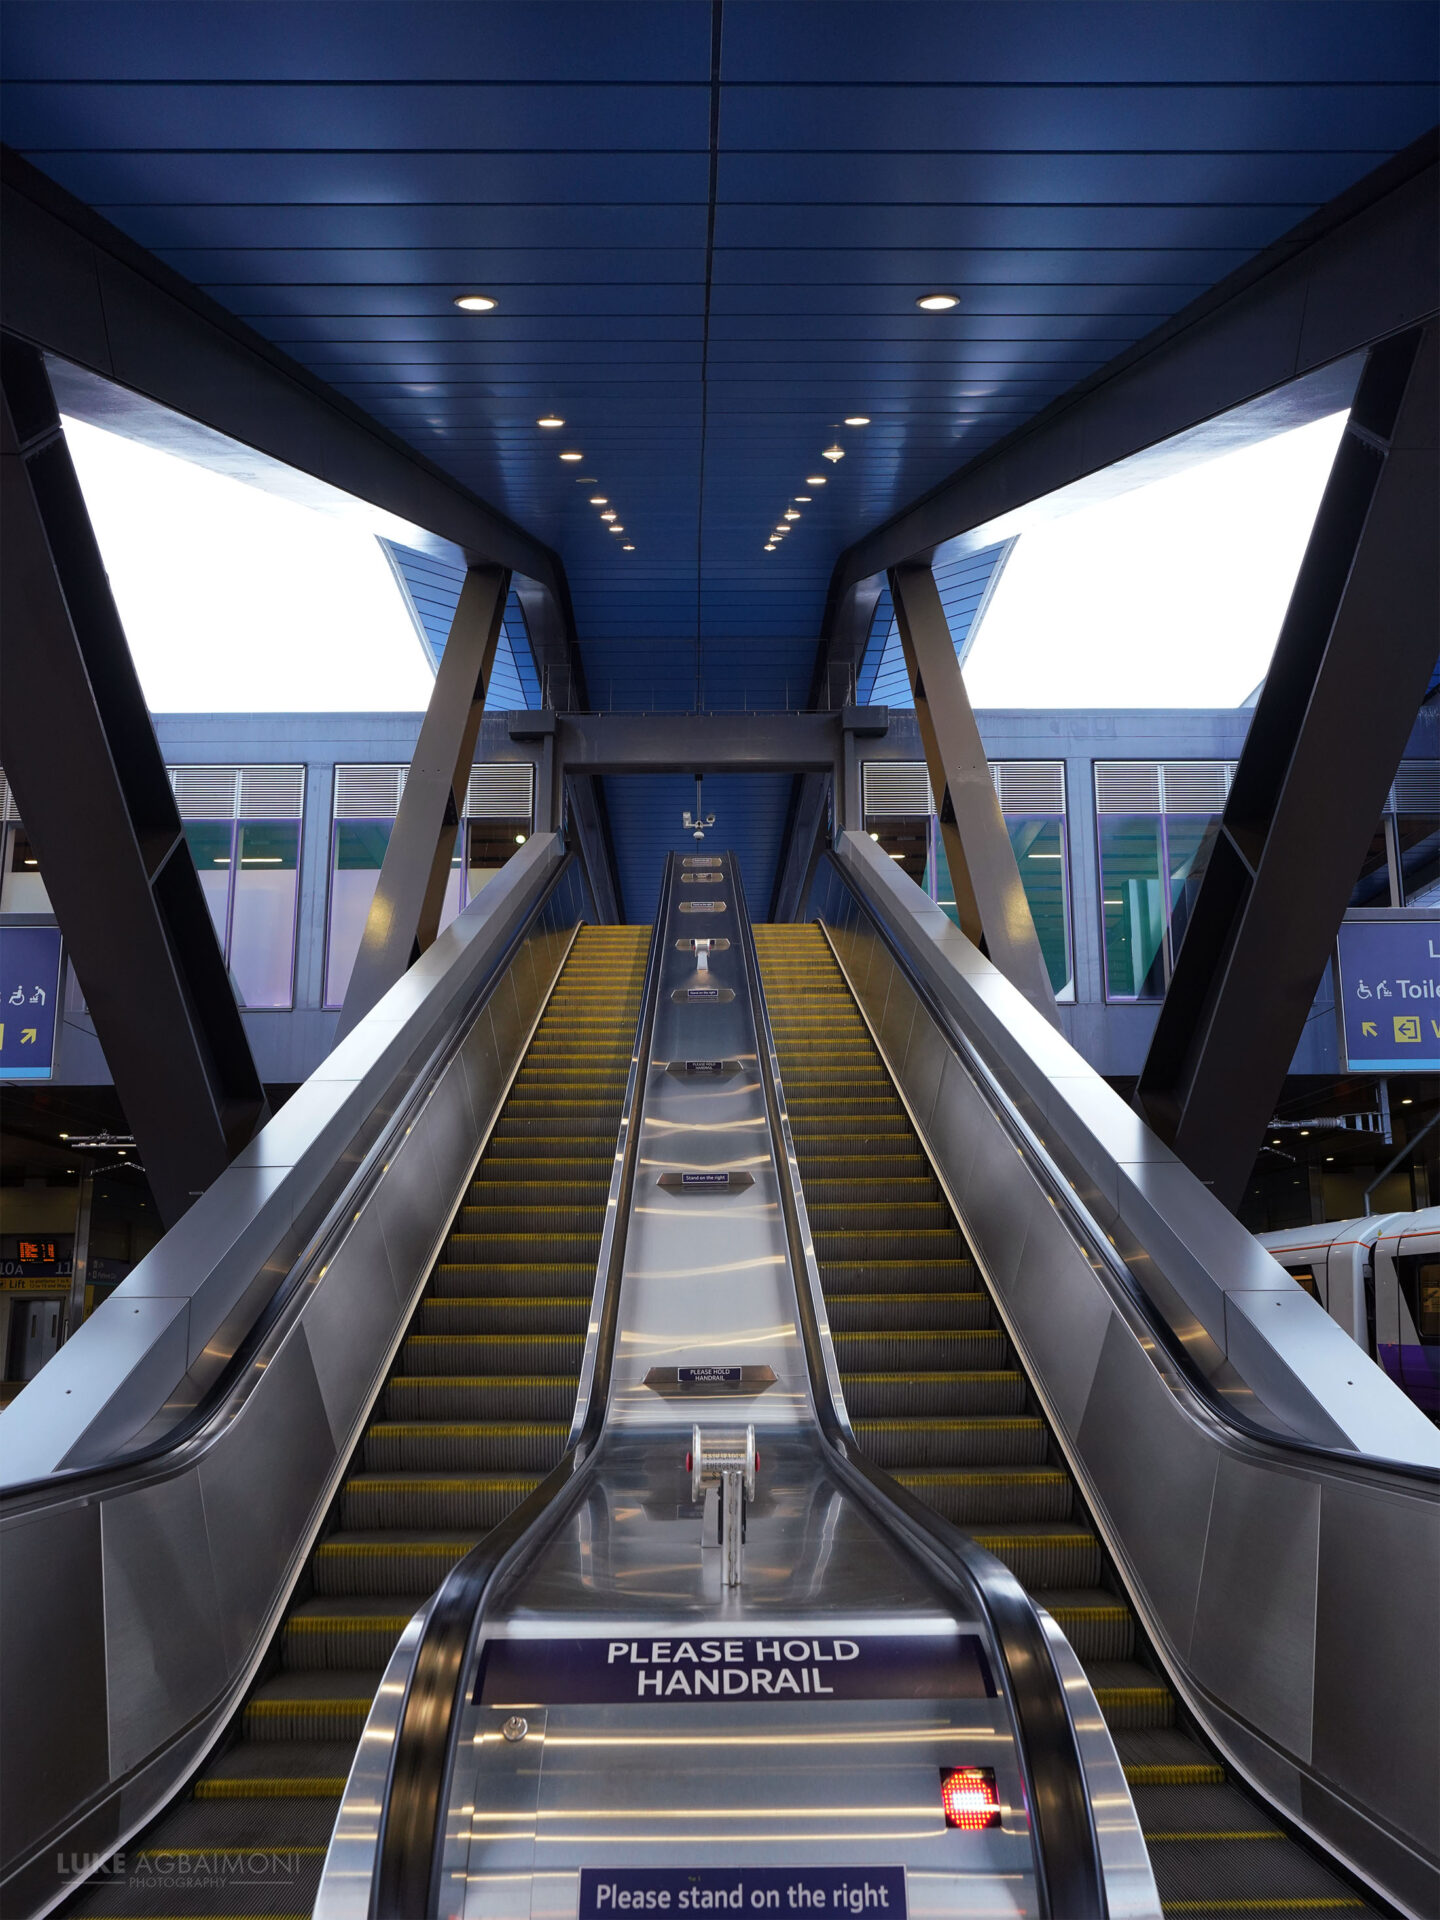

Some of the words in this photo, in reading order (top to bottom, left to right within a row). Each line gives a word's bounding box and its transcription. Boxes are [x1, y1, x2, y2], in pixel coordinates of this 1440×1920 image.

[9, 1280, 26, 1288] Lift
[607, 1642, 744, 1663] PLEASE
[756, 1640, 860, 1662] HOLD
[637, 1668, 834, 1696] HANDRAIL
[596, 1884, 671, 1909] Please
[678, 1883, 743, 1909] stand
[750, 1888, 780, 1908] on
[787, 1883, 826, 1908] the
[833, 1882, 889, 1913] right
